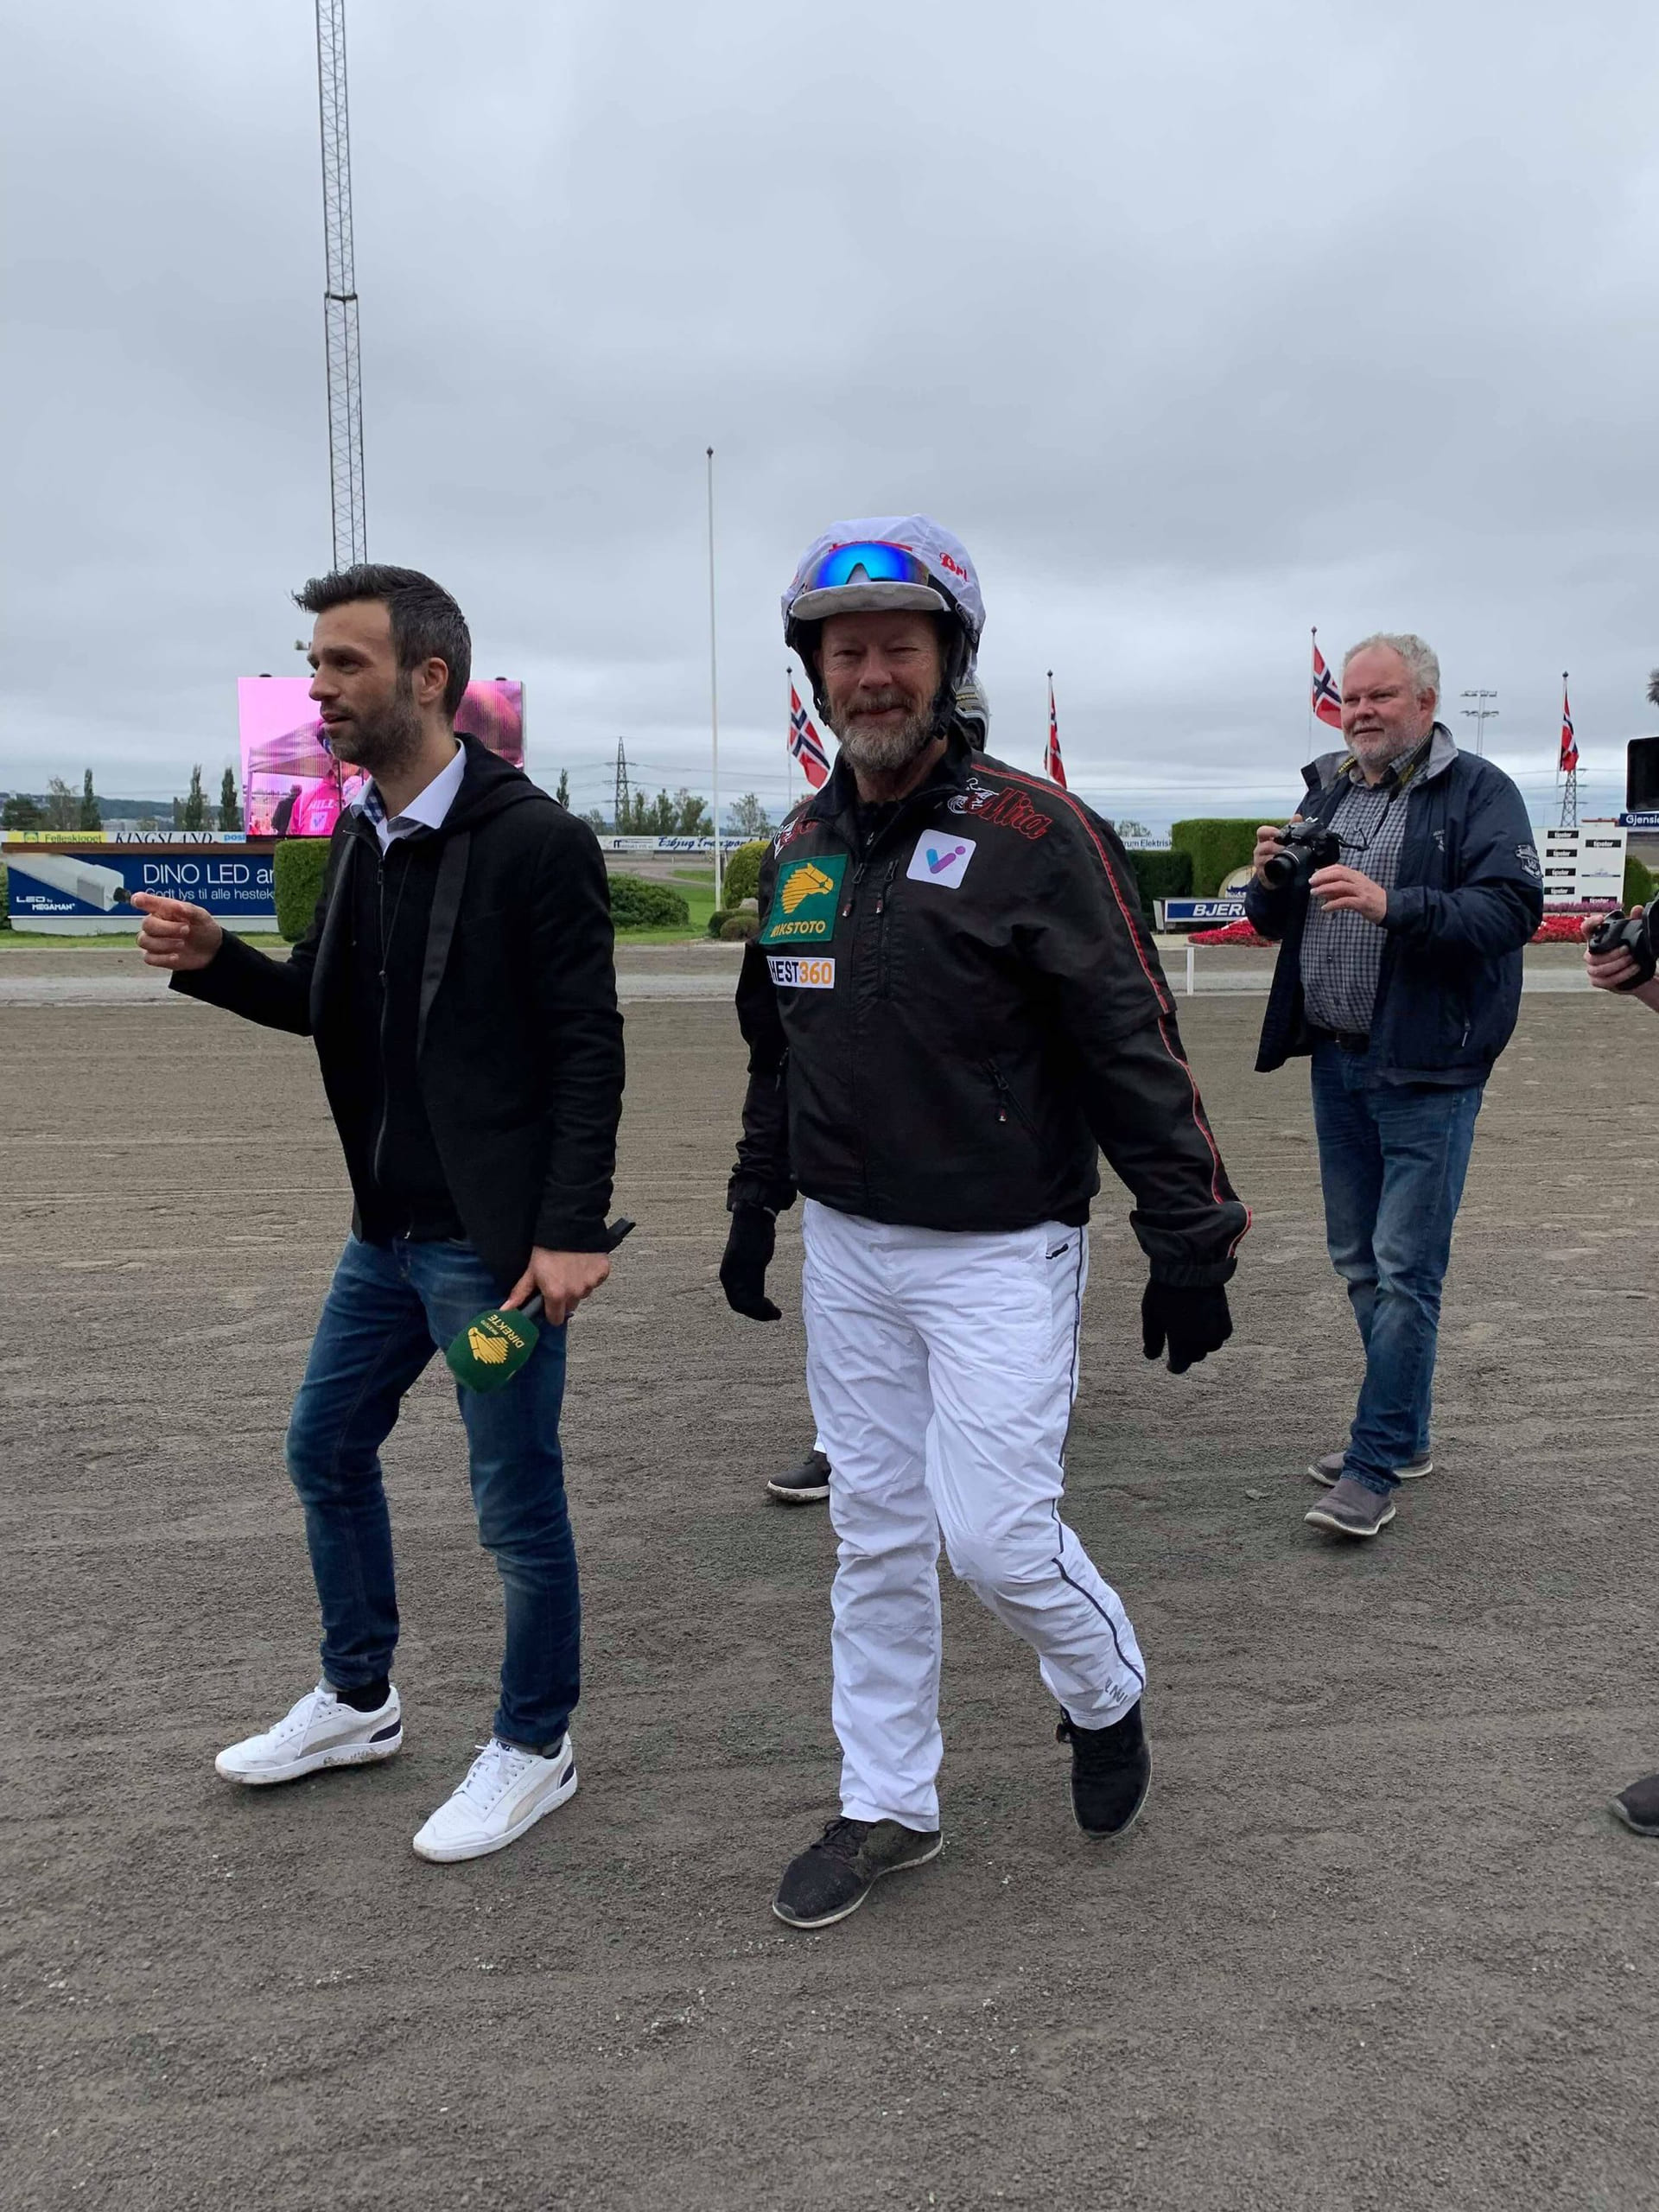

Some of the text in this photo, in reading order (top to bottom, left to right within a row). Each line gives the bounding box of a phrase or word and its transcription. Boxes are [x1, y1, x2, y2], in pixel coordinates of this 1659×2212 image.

[116, 833, 213, 843] KINGSLAND
[143, 864, 200, 884] DINO
[207, 864, 250, 884] LED
[179, 888, 194, 901] lys
[199, 888, 207, 899] til
[212, 888, 230, 899] alle
[771, 920, 826, 938] RIKSTOTO
[769, 960, 832, 984] HEST360
[487, 1314, 525, 1349] DIREKTE
